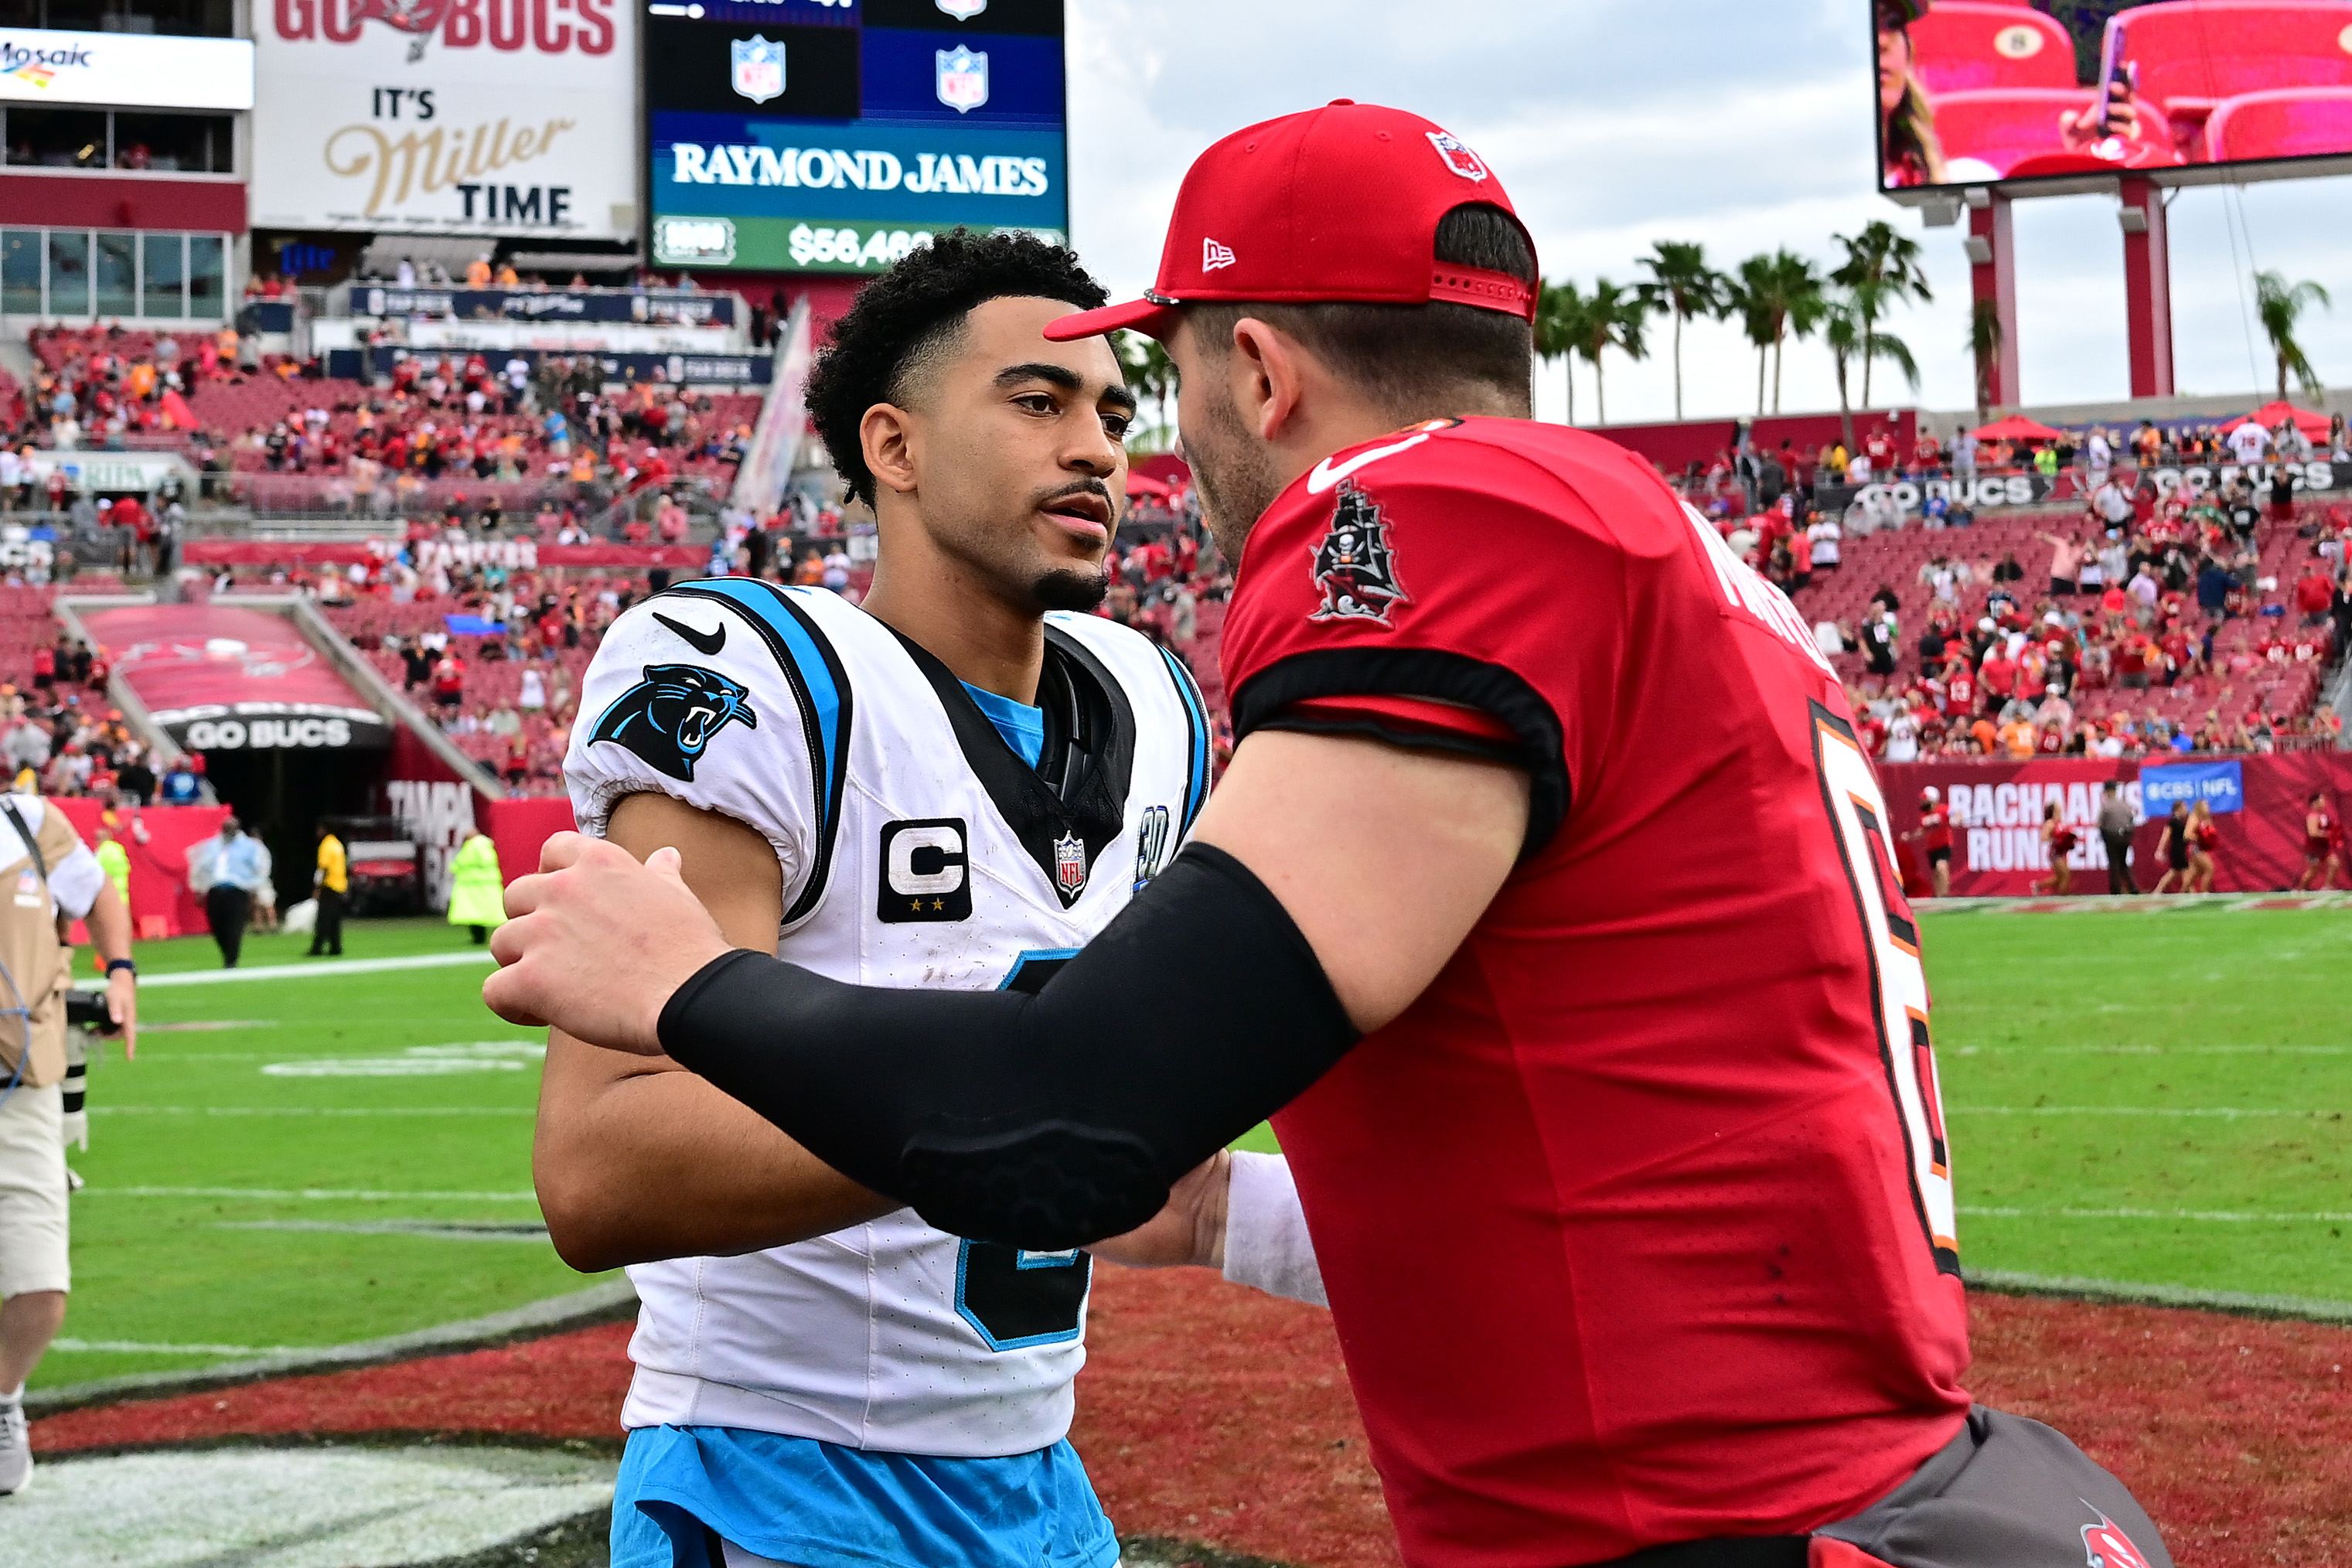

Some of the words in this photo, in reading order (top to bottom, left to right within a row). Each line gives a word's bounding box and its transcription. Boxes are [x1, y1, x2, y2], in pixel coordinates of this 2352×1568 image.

[373, 88, 435, 119] IT'S
[326, 118, 576, 218] Miller
[672, 142, 902, 190] RAYMOND
[905, 153, 1048, 196] JAMES
[457, 185, 571, 226] TIME
[186, 721, 247, 750] GO
[249, 718, 352, 749] BUCS
[888, 826, 964, 895] C
[1061, 862, 1082, 886] NFL
